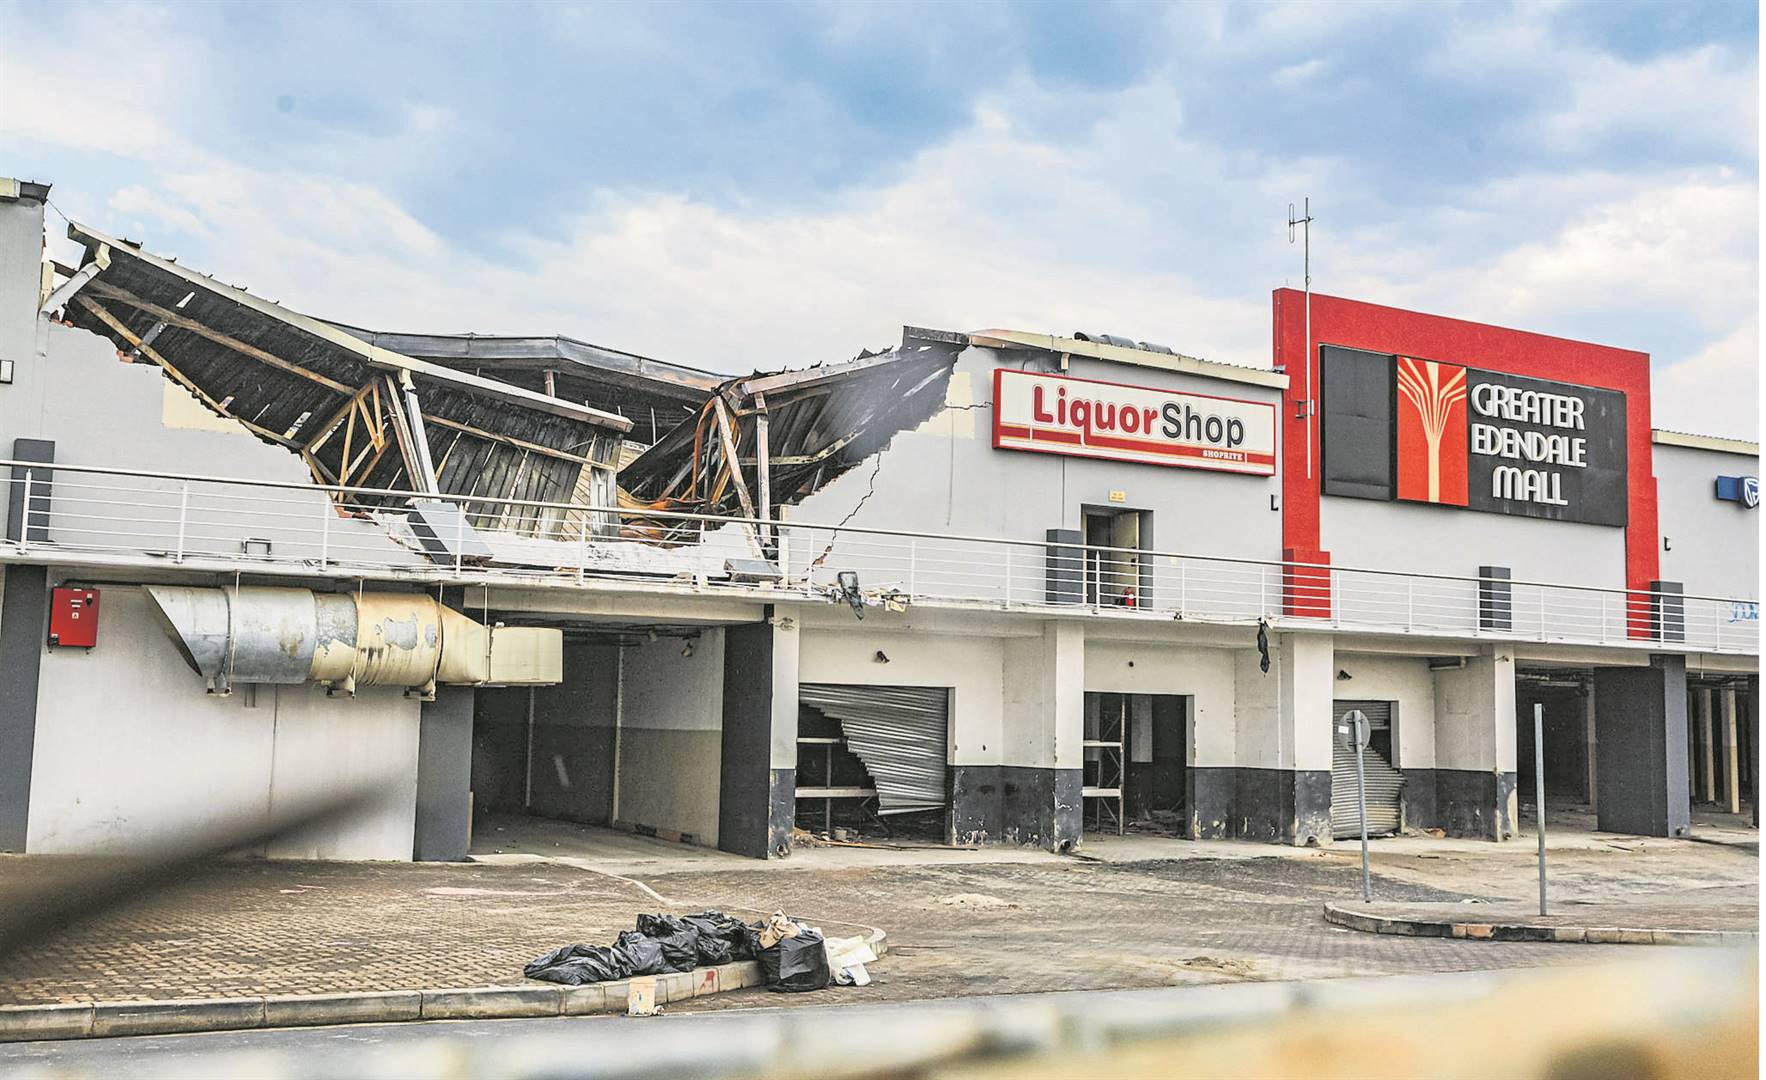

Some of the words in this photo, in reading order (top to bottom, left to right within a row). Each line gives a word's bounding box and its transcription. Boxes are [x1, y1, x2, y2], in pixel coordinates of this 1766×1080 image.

[1471, 383, 1585, 430] GREATER
[1202, 449, 1243, 461] SHOPRITE
[1471, 423, 1587, 468] EDENDALE
[1493, 465, 1568, 506] MALL
